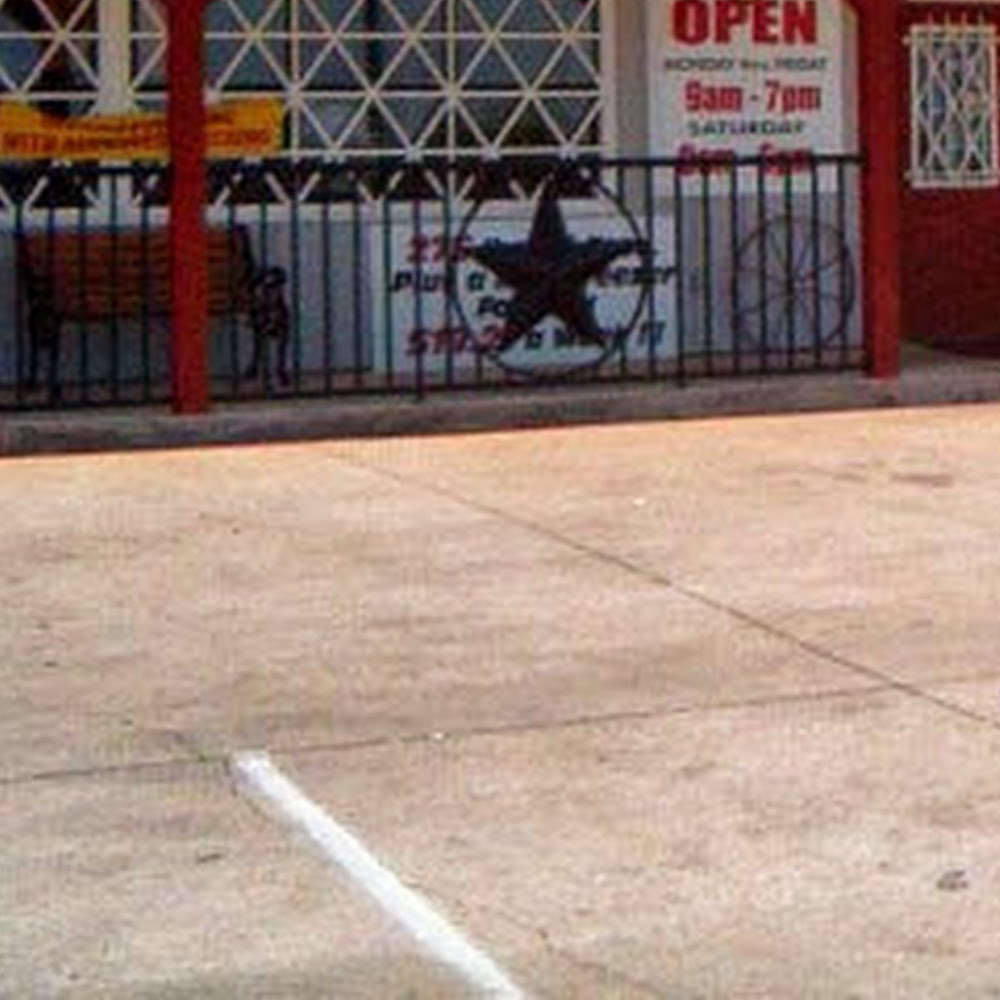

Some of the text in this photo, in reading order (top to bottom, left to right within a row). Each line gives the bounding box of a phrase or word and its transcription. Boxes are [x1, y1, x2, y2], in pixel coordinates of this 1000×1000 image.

[685, 78, 744, 112] 9am
[765, 79, 822, 114] 7pm
[687, 119, 806, 136] SATURDAY
